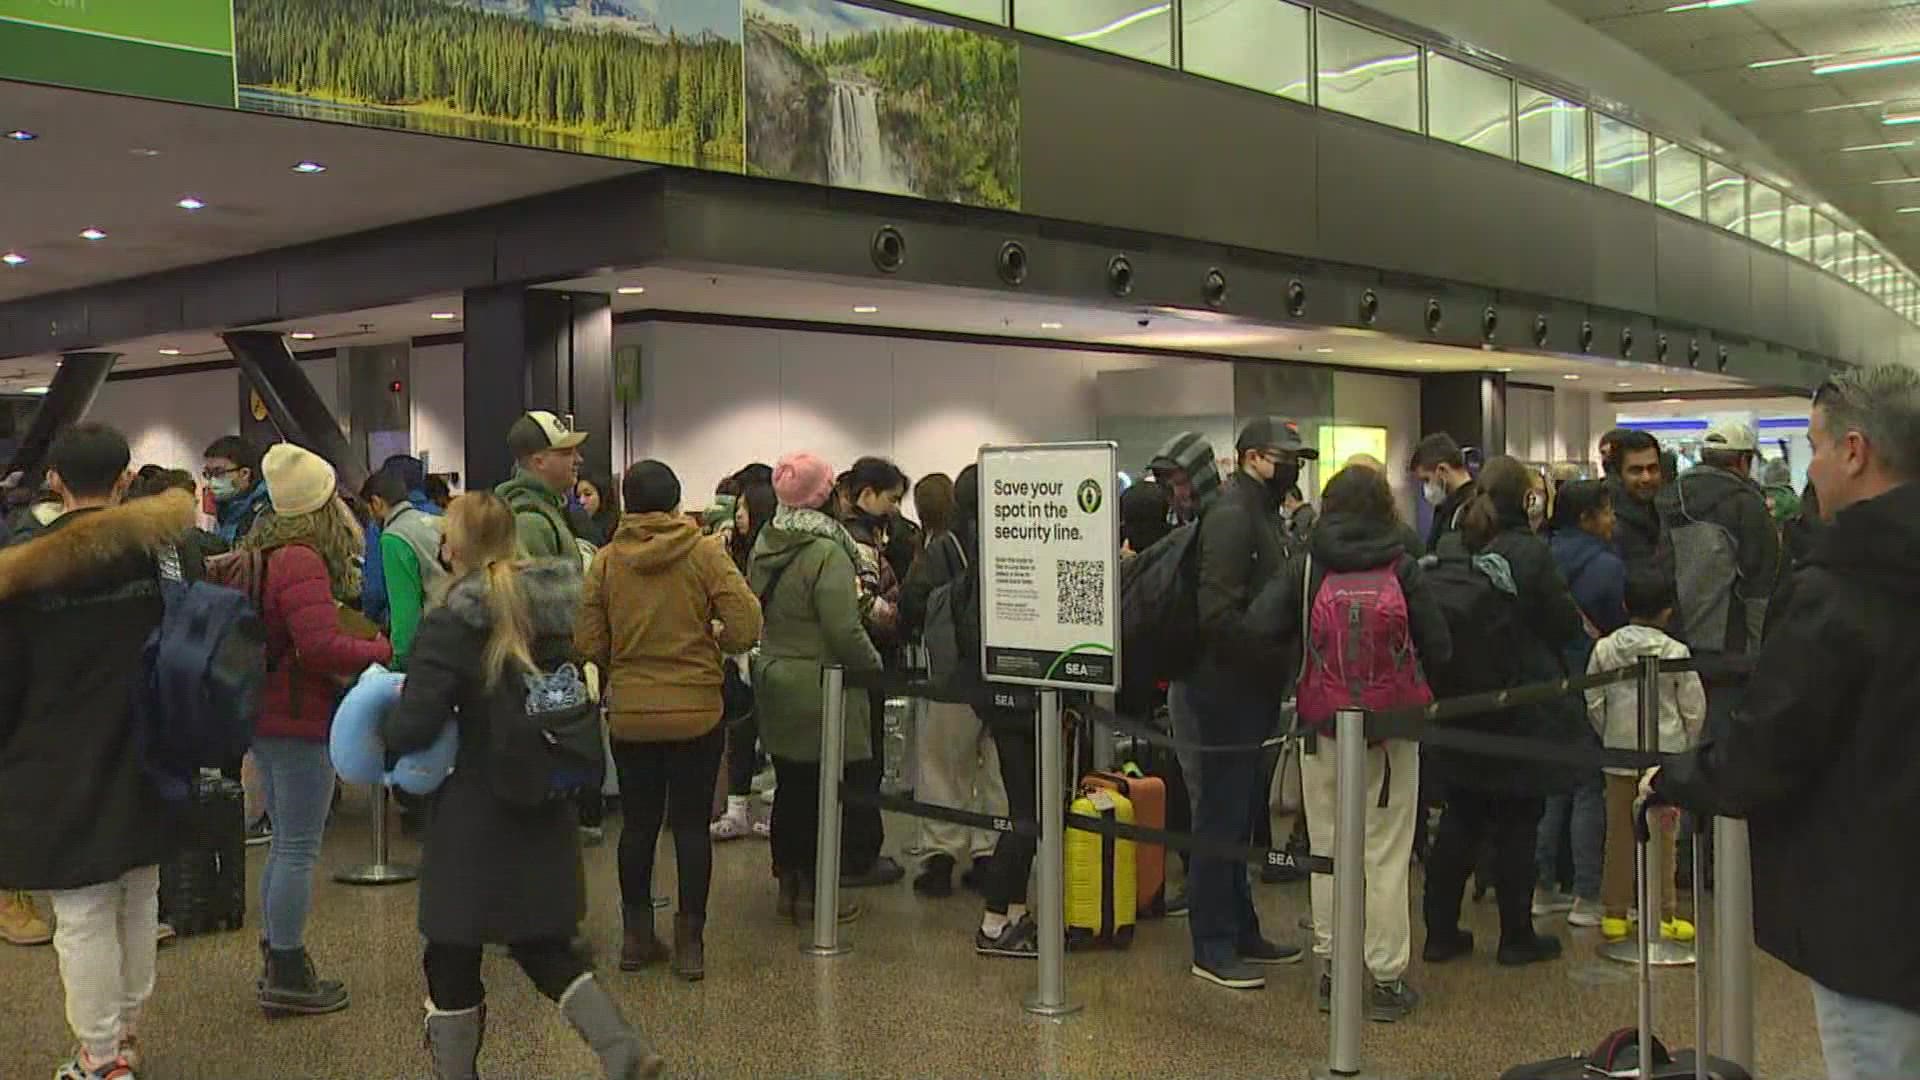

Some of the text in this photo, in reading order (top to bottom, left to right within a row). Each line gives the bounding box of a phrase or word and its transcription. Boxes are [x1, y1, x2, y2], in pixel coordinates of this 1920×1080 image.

[994, 479, 1029, 496] Save
[1031, 481, 1063, 499] your
[994, 501, 1068, 521] spot in the
[994, 523, 1083, 544] security line.
[1065, 663, 1088, 676] SEA
[994, 694, 1016, 708] SEA
[992, 818, 1014, 832] SEA
[1267, 852, 1295, 867] SEA
